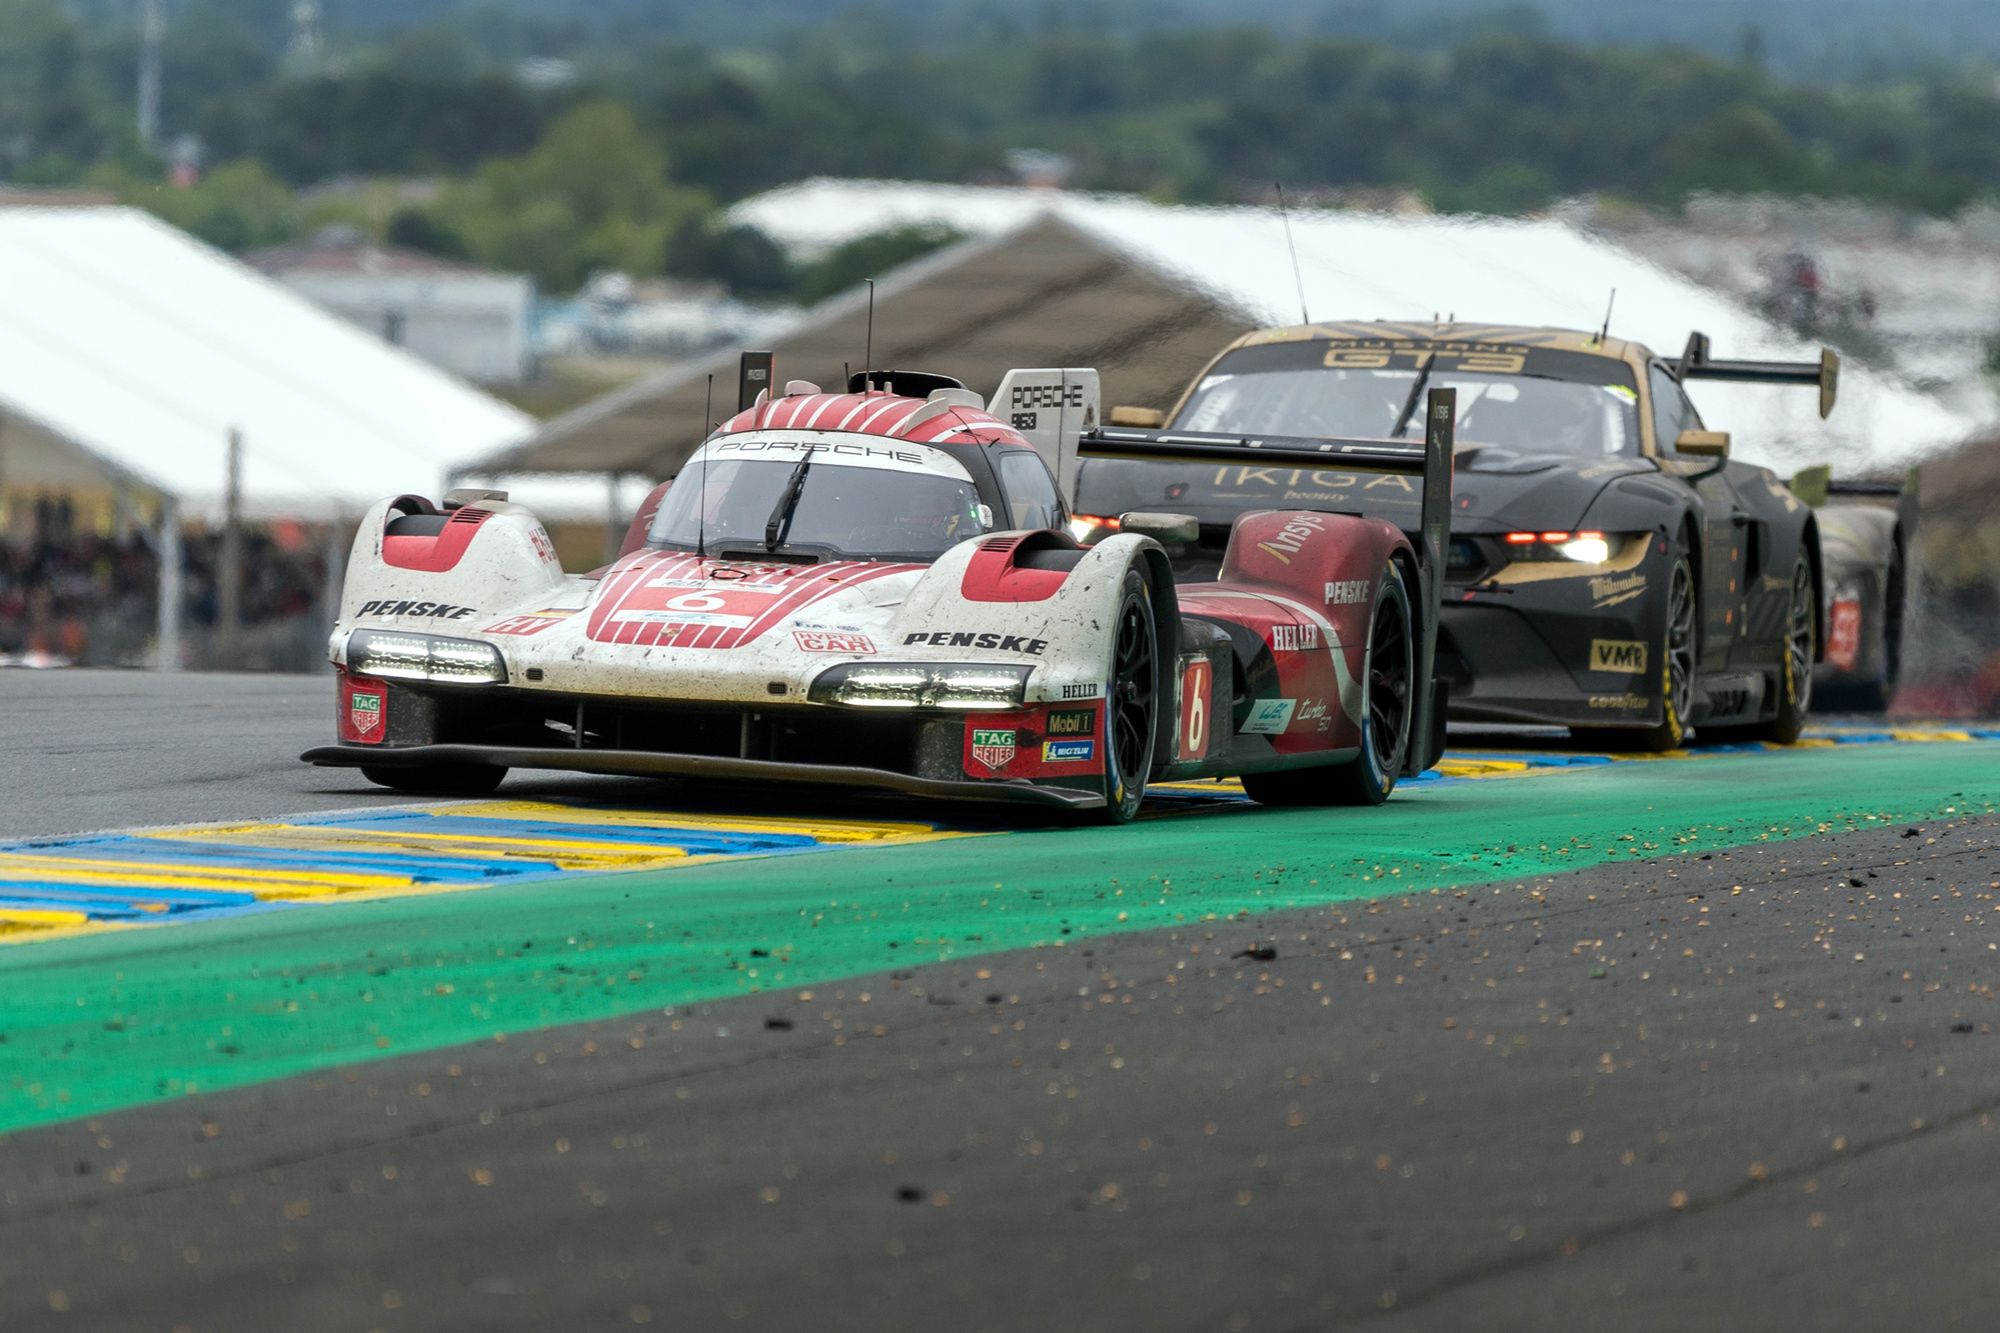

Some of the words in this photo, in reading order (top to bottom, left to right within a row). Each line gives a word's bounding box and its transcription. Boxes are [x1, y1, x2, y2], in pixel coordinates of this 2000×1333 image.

[1323, 349, 1526, 374] GT3
[1011, 384, 1083, 409] PORSCHE
[717, 441, 923, 465] PORSCHE
[1257, 514, 1325, 566] Ansys
[665, 589, 726, 612] 6
[1324, 580, 1369, 605] PENSKE
[355, 600, 477, 619] PENSKE
[803, 639, 869, 652] CAR
[903, 632, 1048, 655] PENSKE
[1272, 624, 1318, 650] HELLER
[1062, 683, 1098, 698] HELLER
[354, 697, 377, 710] TAG
[1188, 667, 1204, 752] 6
[1049, 714, 1080, 733] Mobil
[977, 732, 1012, 745] TAG
[975, 746, 1013, 766] HEUER
